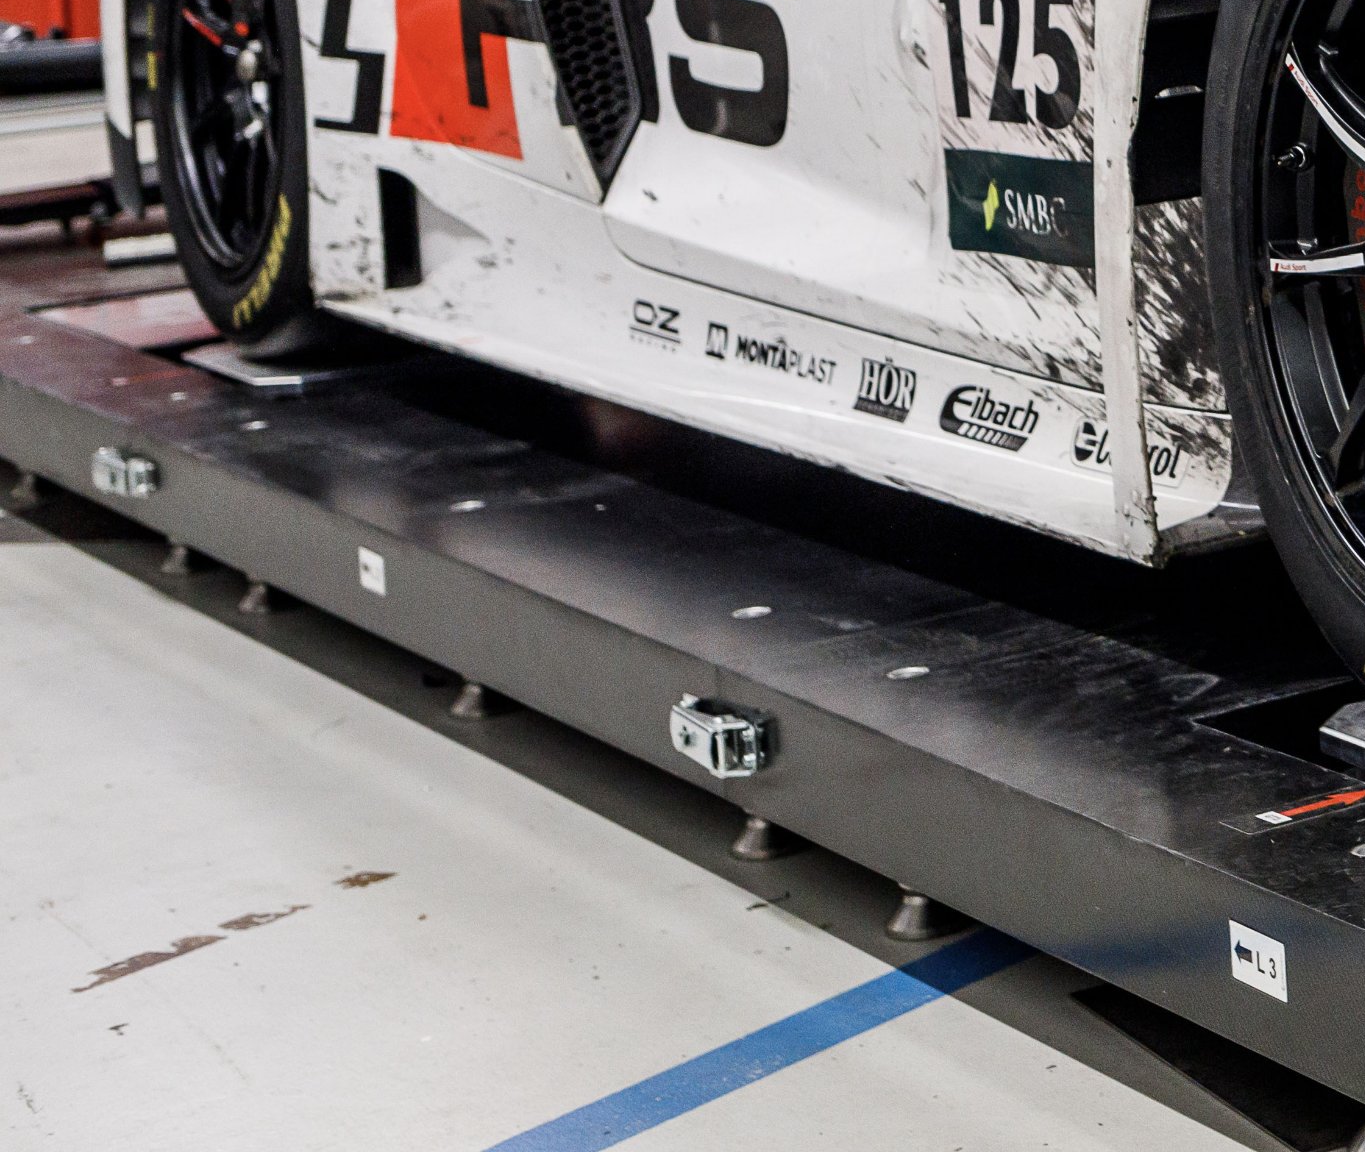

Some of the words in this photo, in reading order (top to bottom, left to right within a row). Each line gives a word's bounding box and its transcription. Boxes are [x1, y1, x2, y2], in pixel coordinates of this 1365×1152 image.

[1005, 189, 1068, 237] SMBC
[633, 300, 680, 334] OZ
[861, 356, 915, 411] HÖR
[940, 385, 1039, 434] Eibach
[1096, 429, 1180, 478] Crol
